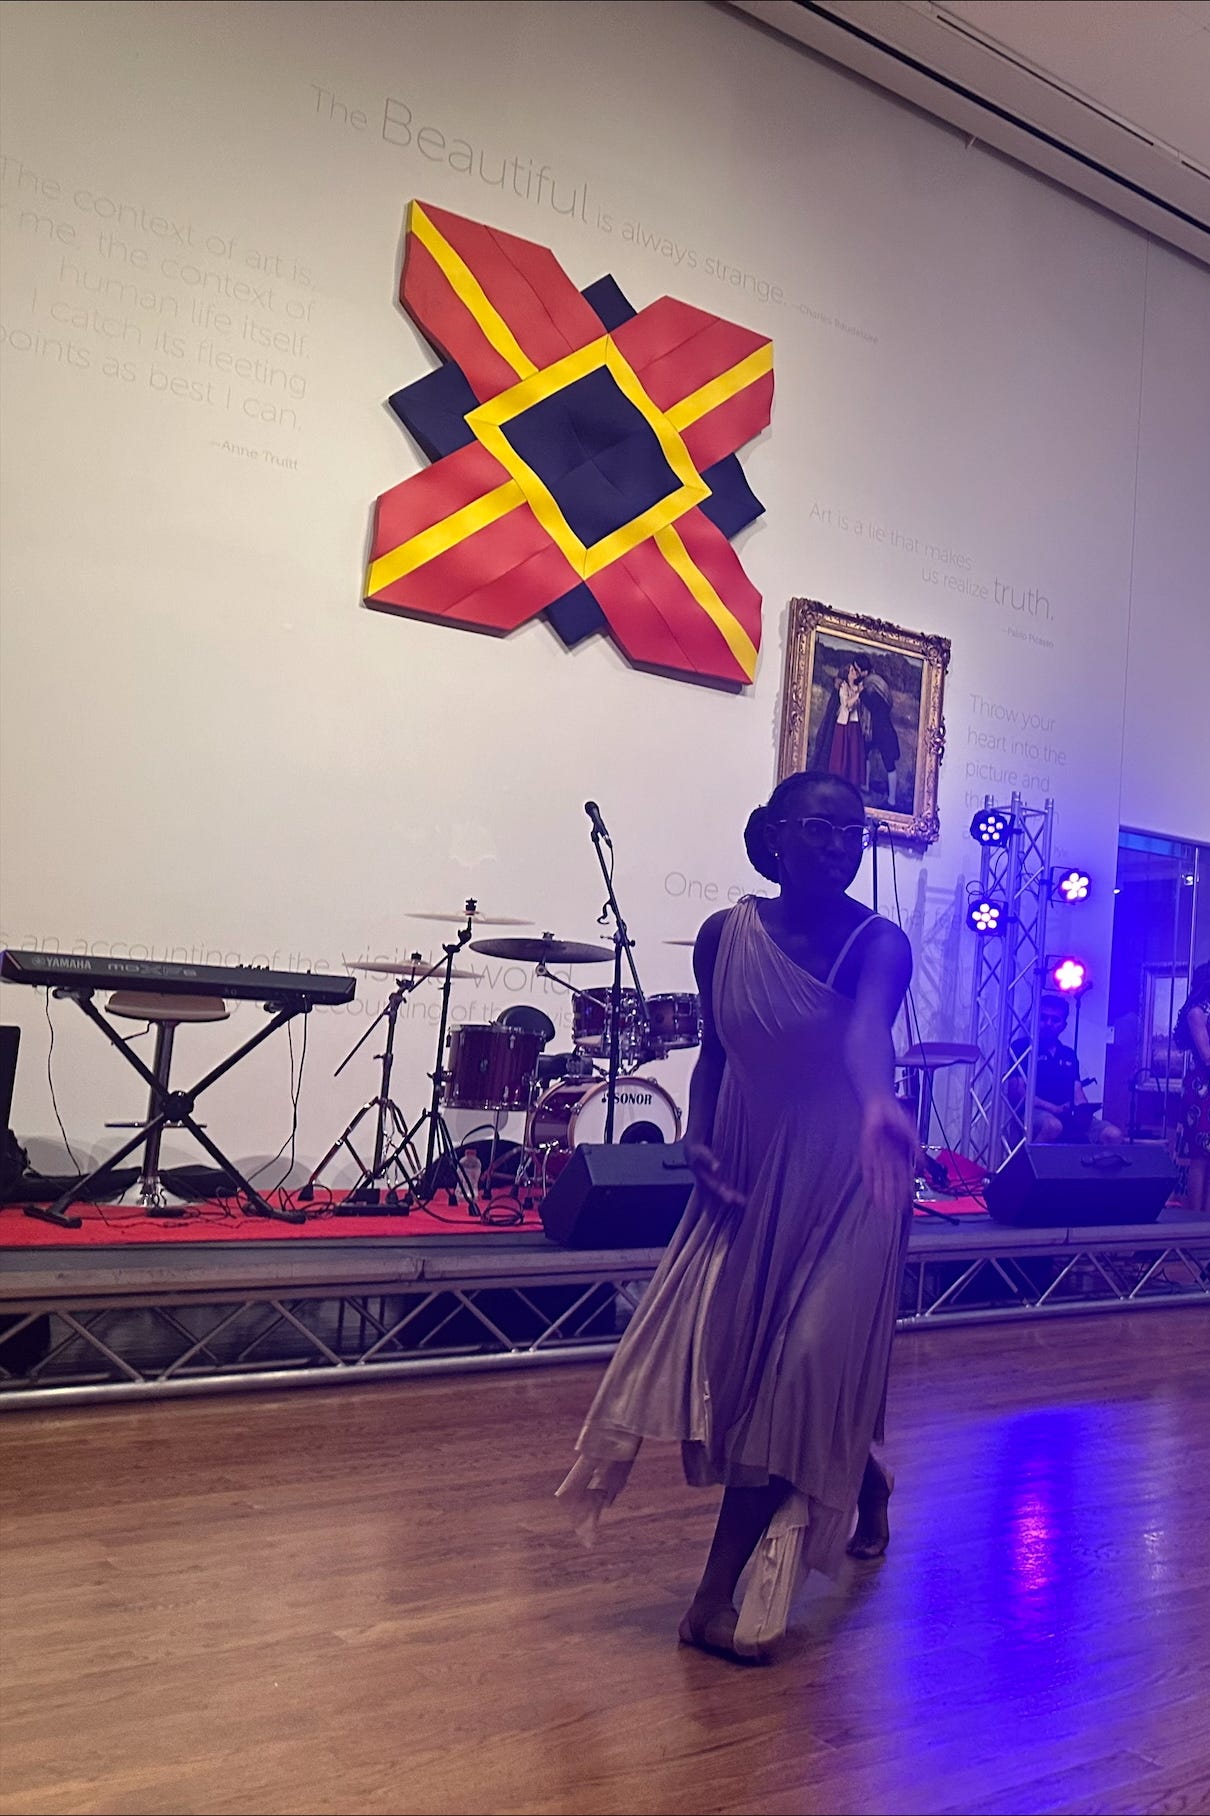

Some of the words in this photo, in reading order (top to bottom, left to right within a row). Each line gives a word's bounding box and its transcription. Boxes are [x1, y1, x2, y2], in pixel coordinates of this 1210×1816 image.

[0, 155, 61, 200] The
[73, 189, 194, 248] context
[205, 233, 237, 260] of
[244, 249, 284, 278] art
[311, 84, 368, 131] The
[382, 97, 588, 224] Beautiful
[597, 207, 613, 233] is
[621, 221, 698, 268] always
[704, 255, 789, 306] strange.
[59, 255, 179, 318] human
[190, 301, 233, 335] life
[97, 230, 149, 269] the
[160, 257, 275, 312] context
[284, 299, 316, 323] of
[31, 287, 38, 314] I
[49, 300, 143, 346] catch
[153, 328, 188, 360] its
[196, 338, 308, 400] fleeting
[101, 355, 137, 383] as
[149, 363, 215, 407] best
[225, 387, 232, 410] I
[809, 502, 833, 524] Art
[837, 509, 850, 531] is
[854, 521, 864, 535] a
[868, 522, 886, 543] lie
[891, 529, 920, 553] that
[925, 540, 973, 571] makes
[921, 567, 940, 586] us
[943, 574, 990, 600] realize
[994, 577, 1055, 622] truth.
[969, 693, 1020, 723] Throw
[1022, 713, 1056, 733] your
[967, 725, 1007, 752] heart
[1010, 739, 1040, 760] into
[1044, 746, 1068, 766] the
[965, 760, 1018, 786] picture
[1022, 773, 1051, 792] and
[663, 871, 719, 901] One
[46, 958, 92, 972] YAMAHA
[287, 948, 330, 971] the
[613, 1092, 652, 1105] SONOR
